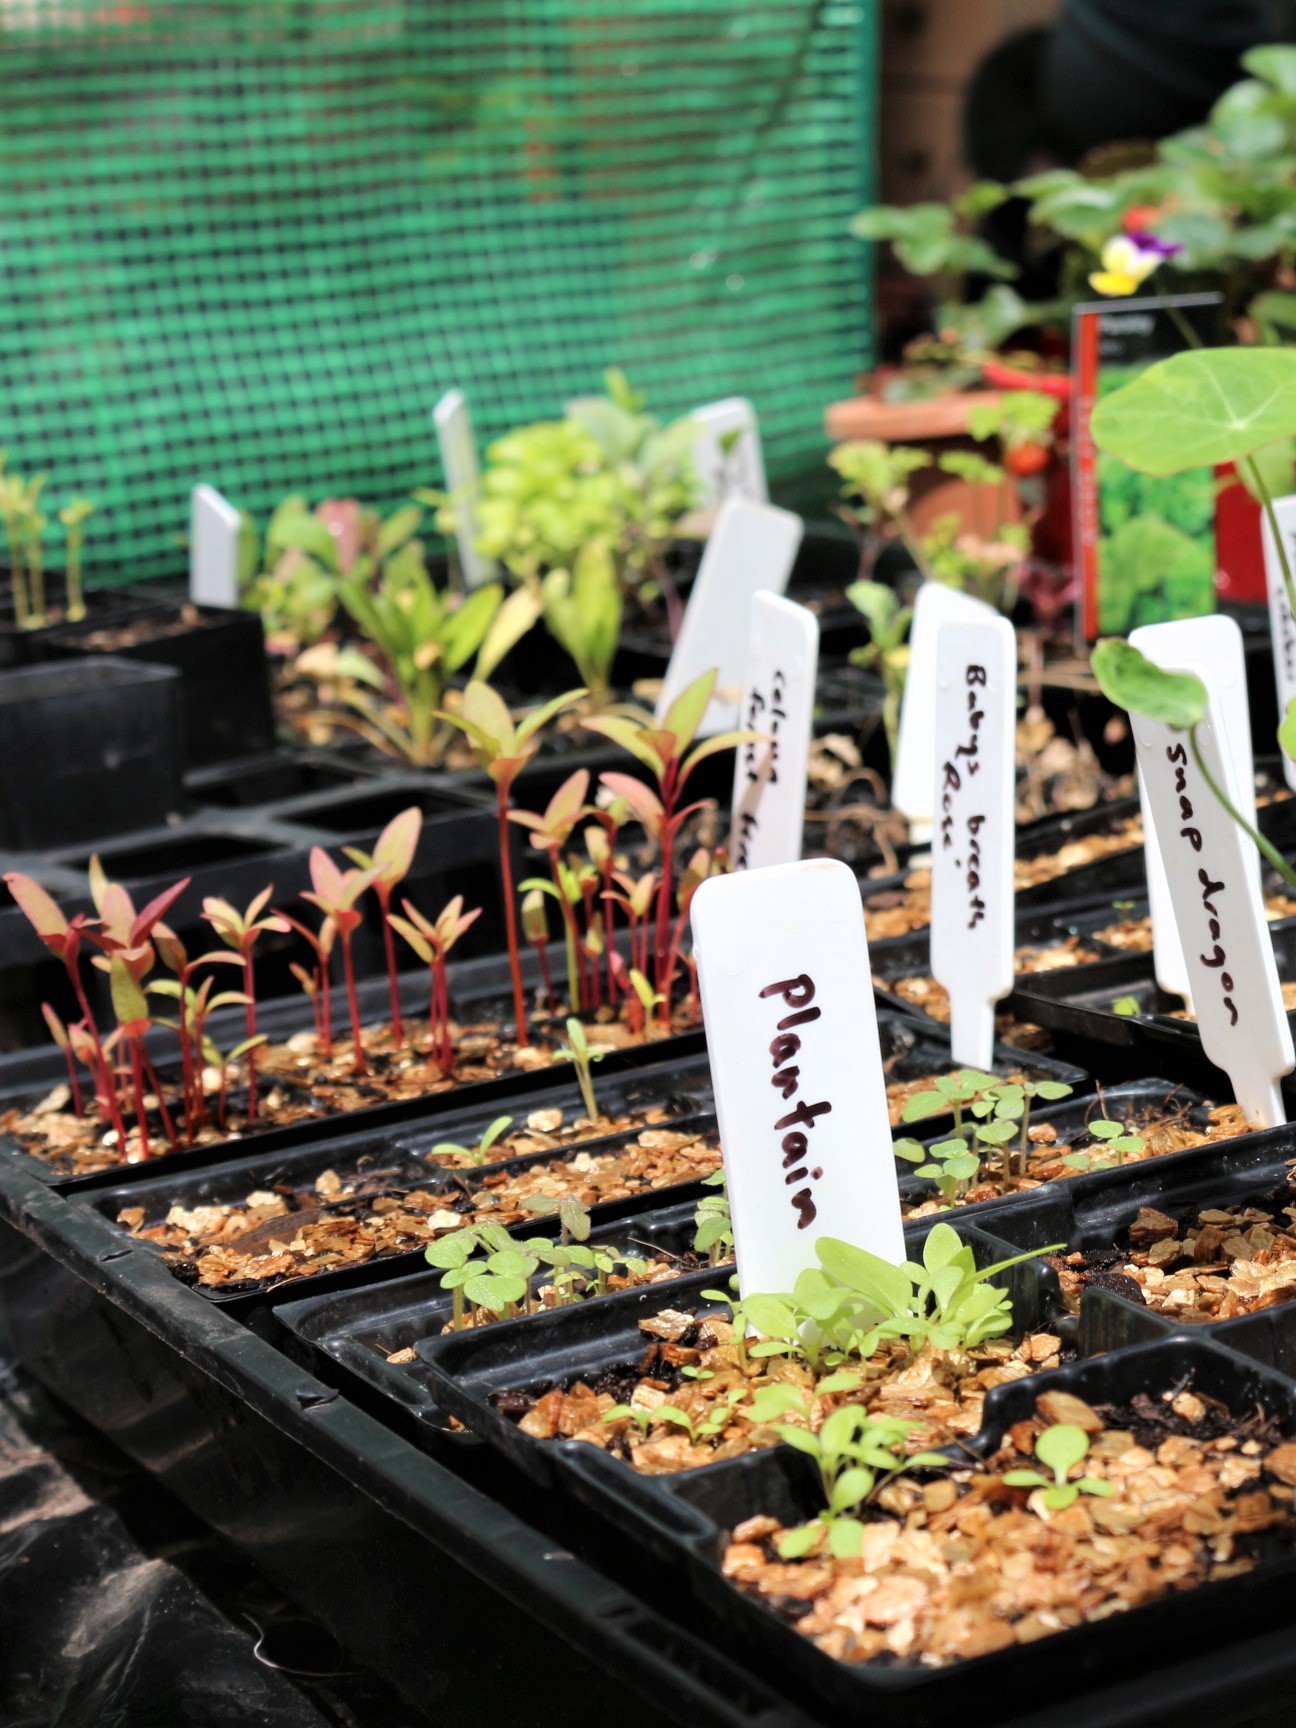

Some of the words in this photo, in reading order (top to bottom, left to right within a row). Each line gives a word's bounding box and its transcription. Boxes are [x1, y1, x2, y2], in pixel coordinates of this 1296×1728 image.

[967, 815, 985, 929] breath
[1167, 743, 1203, 852] snap
[1199, 868, 1238, 1027] dragon
[759, 974, 832, 1230] Plantain
